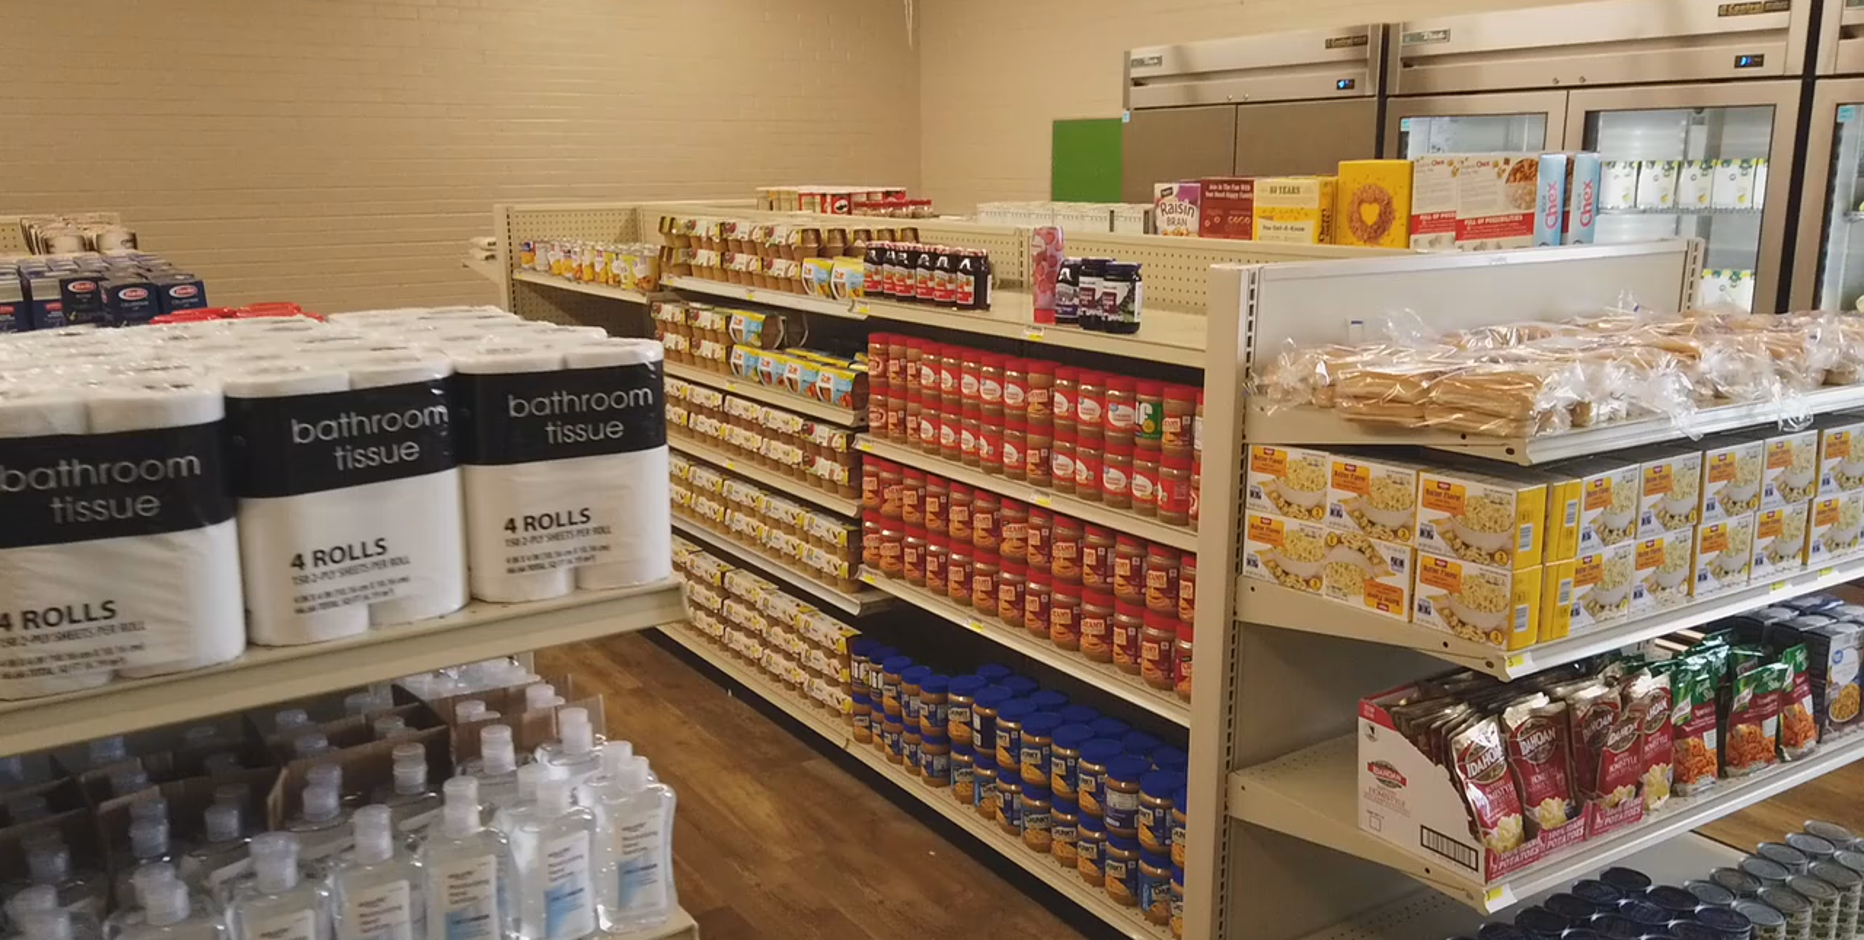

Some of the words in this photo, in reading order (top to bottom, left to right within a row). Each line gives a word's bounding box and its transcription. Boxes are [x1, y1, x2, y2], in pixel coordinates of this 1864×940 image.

[1160, 201, 1195, 218] Raisin
[1545, 181, 1558, 230] Chex
[1580, 178, 1594, 229] Chex
[1166, 216, 1188, 226] BRAN
[508, 386, 653, 418] bathroom
[291, 404, 449, 444] bathroom
[545, 420, 624, 444] tissue
[333, 441, 420, 471] tissue
[0, 455, 201, 492] bathroom
[50, 495, 161, 523] tissue
[503, 517, 517, 534] 4
[523, 507, 591, 533] ROLLS
[290, 552, 306, 570] 4
[313, 538, 388, 568] ROLLS
[0, 612, 13, 631] 4
[22, 600, 117, 631] ROLLS
